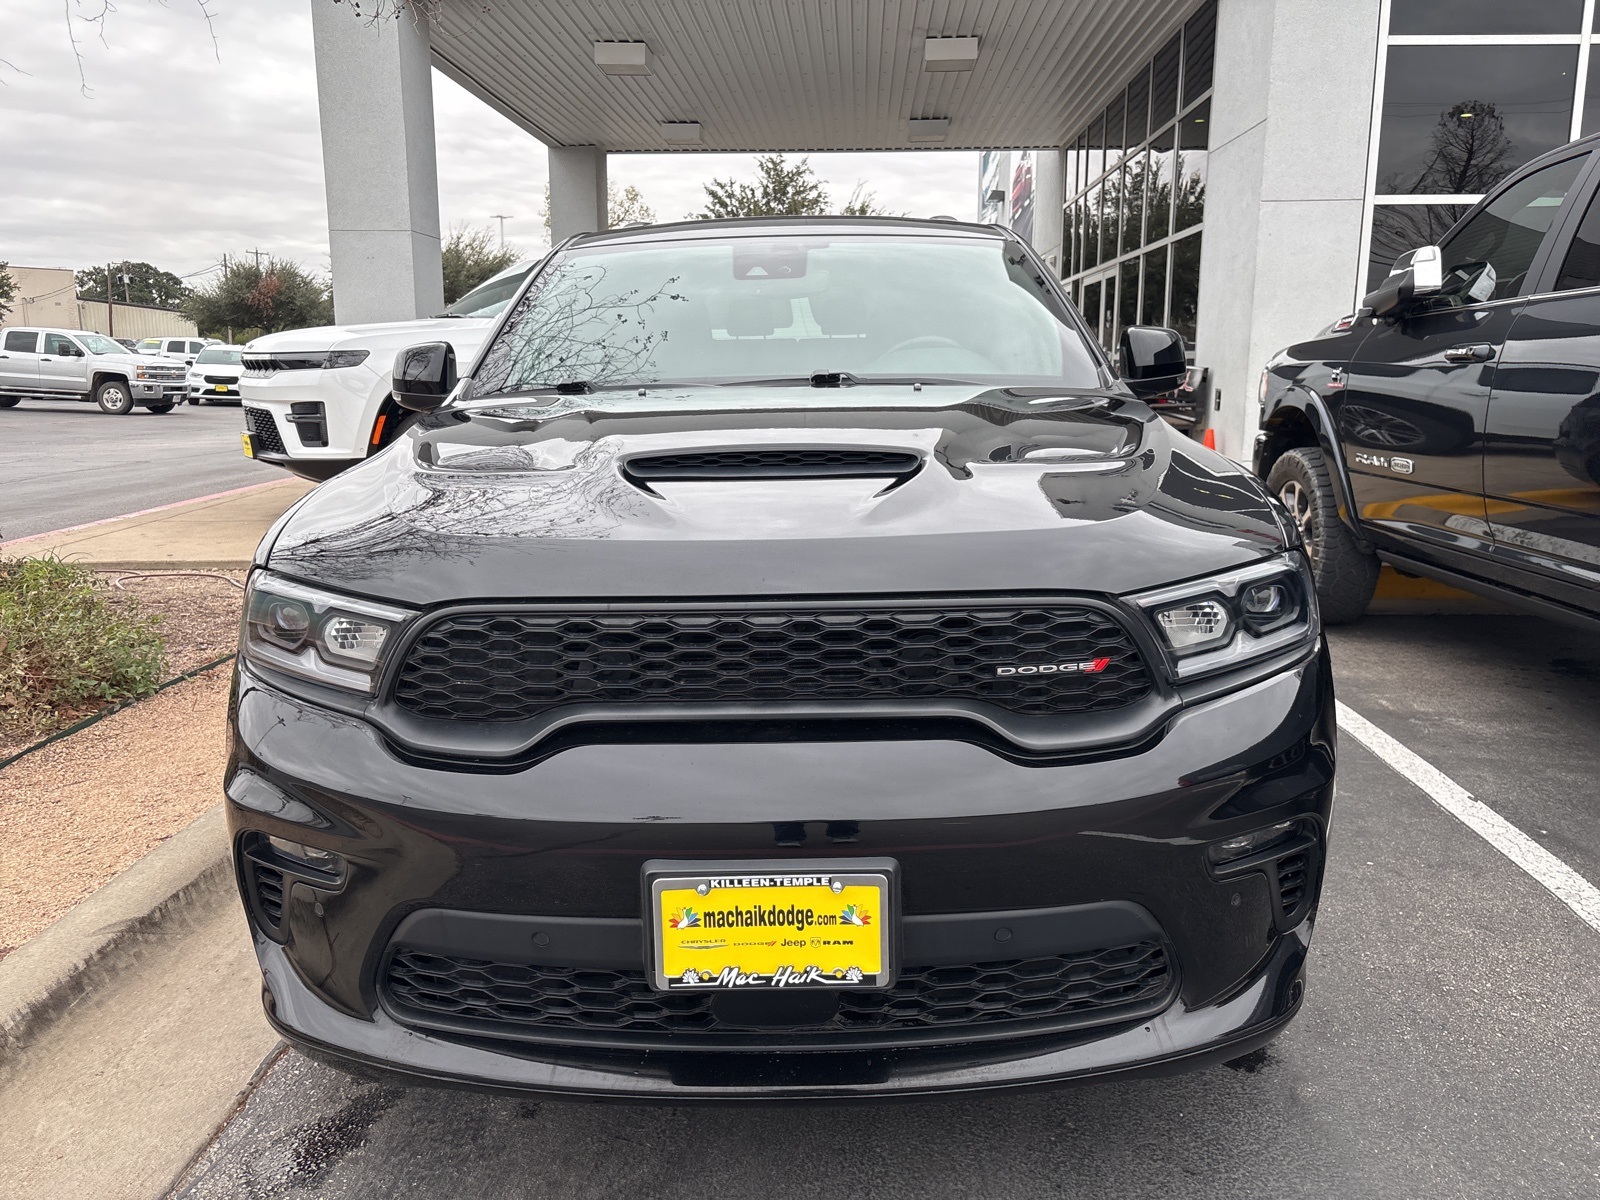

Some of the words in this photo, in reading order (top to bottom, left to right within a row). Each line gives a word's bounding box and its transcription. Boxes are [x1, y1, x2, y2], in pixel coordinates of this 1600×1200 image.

[996, 661, 1096, 676] DODGE
[710, 877, 830, 888] KILLEEN-TEMPLE
[703, 904, 837, 932] machaikdodge.com
[780, 938, 807, 949] Jeep
[716, 965, 766, 988] Mac
[770, 964, 824, 988] Haik
